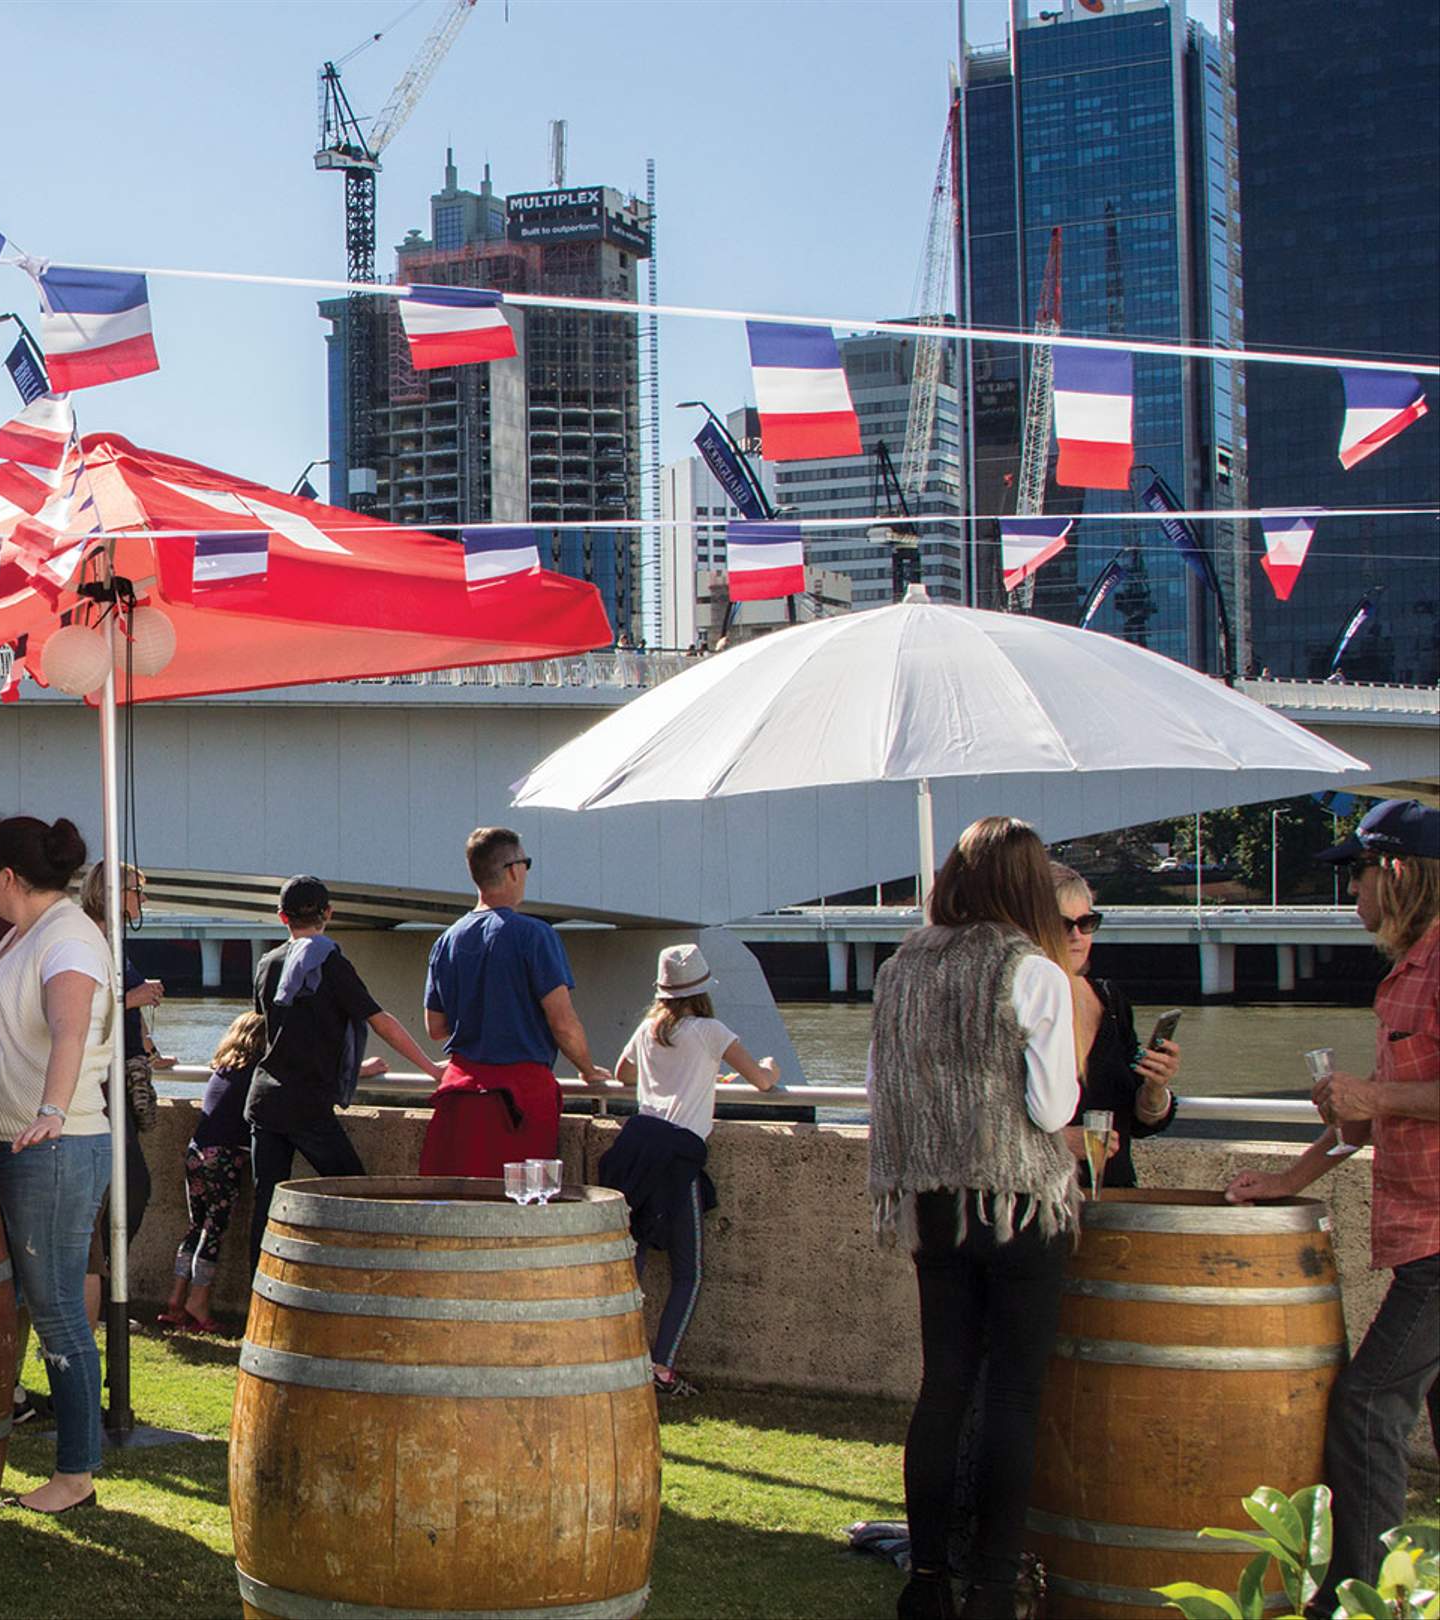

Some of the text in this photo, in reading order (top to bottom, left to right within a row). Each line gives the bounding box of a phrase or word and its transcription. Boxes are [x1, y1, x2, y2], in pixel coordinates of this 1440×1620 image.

[509, 191, 600, 211] MULTIPLEX
[521, 227, 540, 236] Built
[542, 226, 551, 234] to
